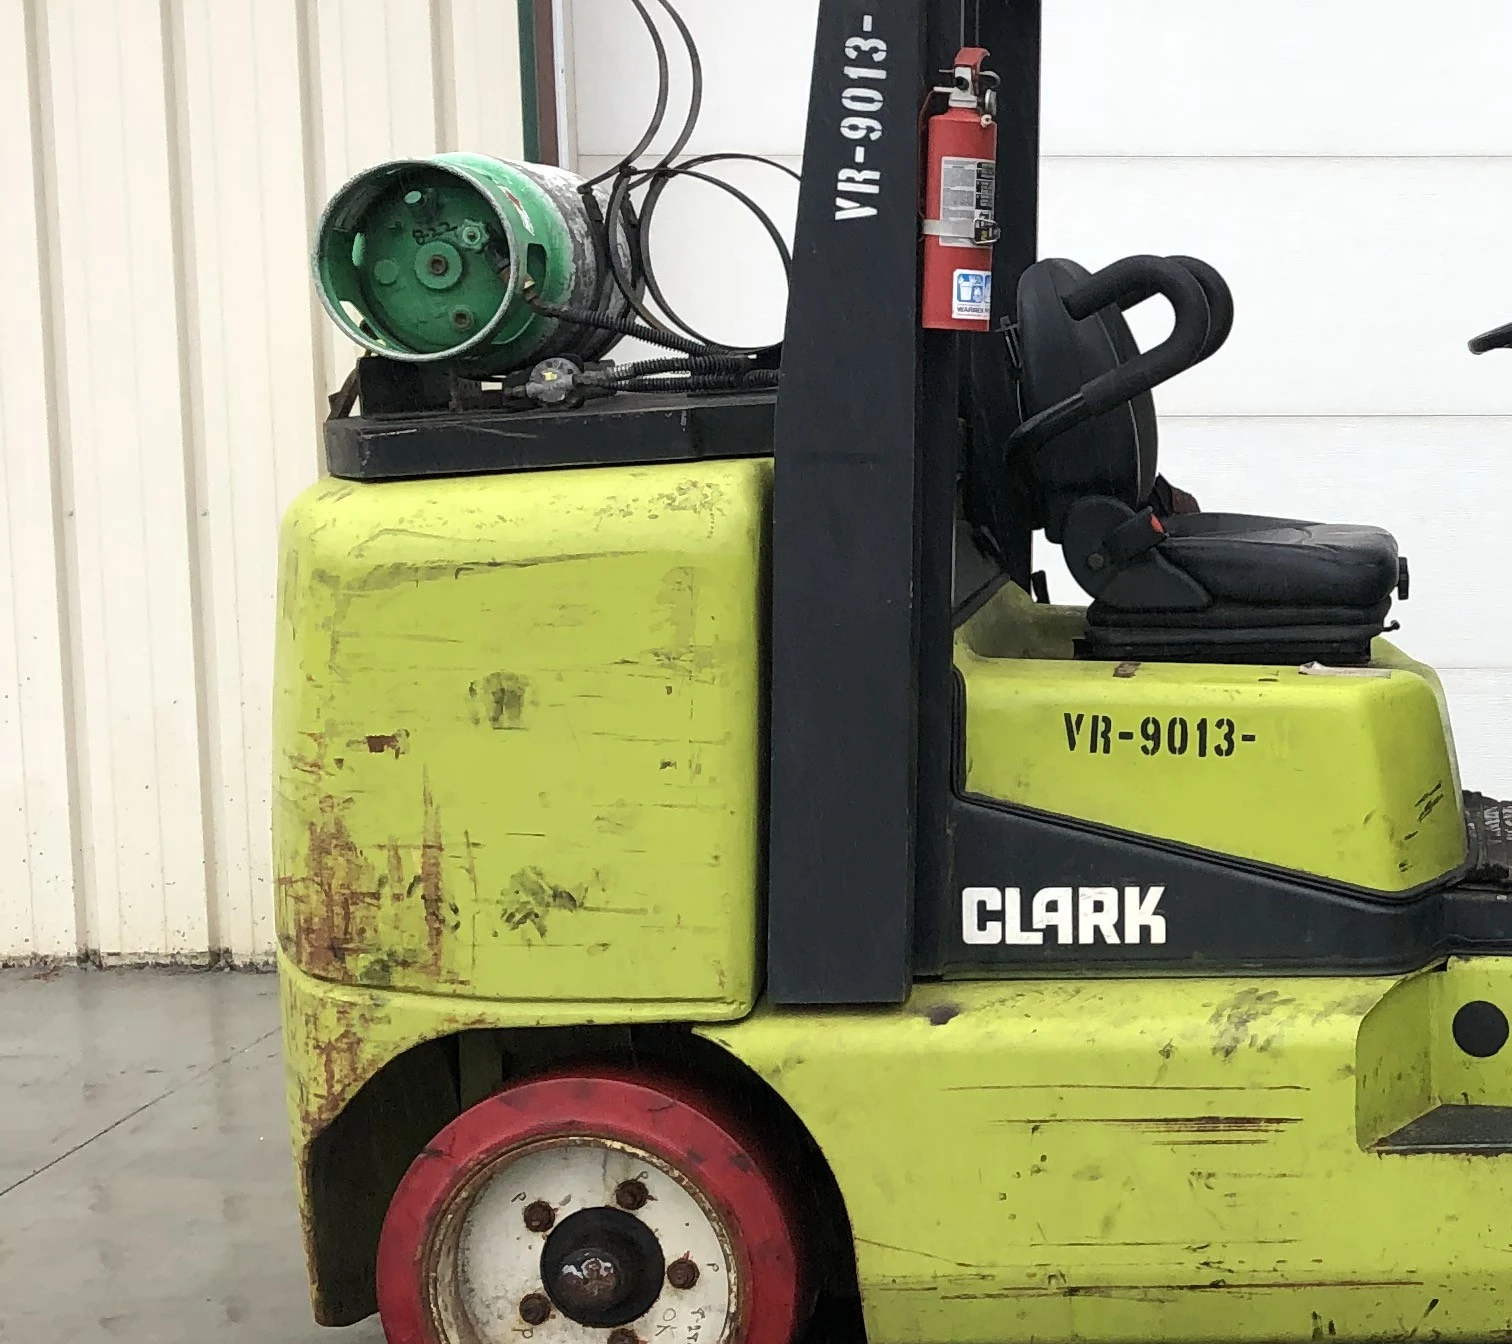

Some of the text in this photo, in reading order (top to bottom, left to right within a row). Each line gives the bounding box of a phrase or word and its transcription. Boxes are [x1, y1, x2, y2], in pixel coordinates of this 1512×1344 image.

[834, 14, 887, 220] VR-9013-
[1063, 712, 1256, 758] VR-9013-
[962, 886, 1167, 945] CLARK
